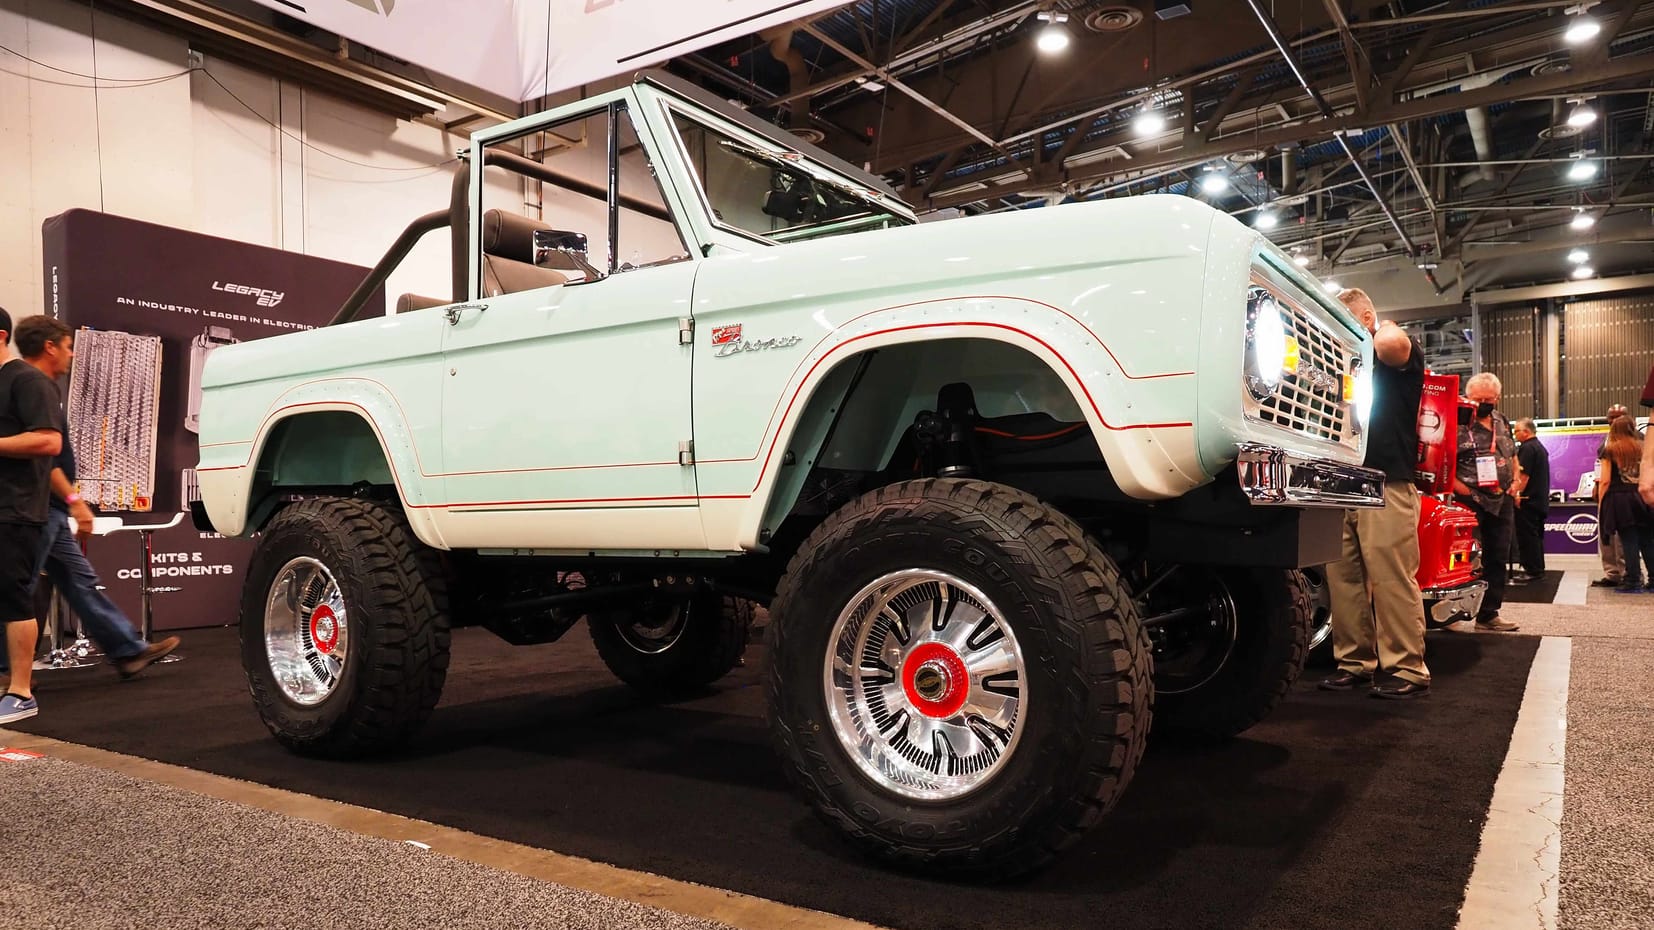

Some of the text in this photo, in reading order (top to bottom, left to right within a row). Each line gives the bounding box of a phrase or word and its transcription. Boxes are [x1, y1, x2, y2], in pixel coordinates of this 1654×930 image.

[211, 281, 285, 300] LEGACY
[256, 297, 281, 307] EV
[116, 297, 135, 305] AN
[138, 299, 199, 315] INDUSTRY
[202, 309, 247, 322] LEADER
[249, 316, 261, 324] IN
[151, 552, 203, 564] KITS &
